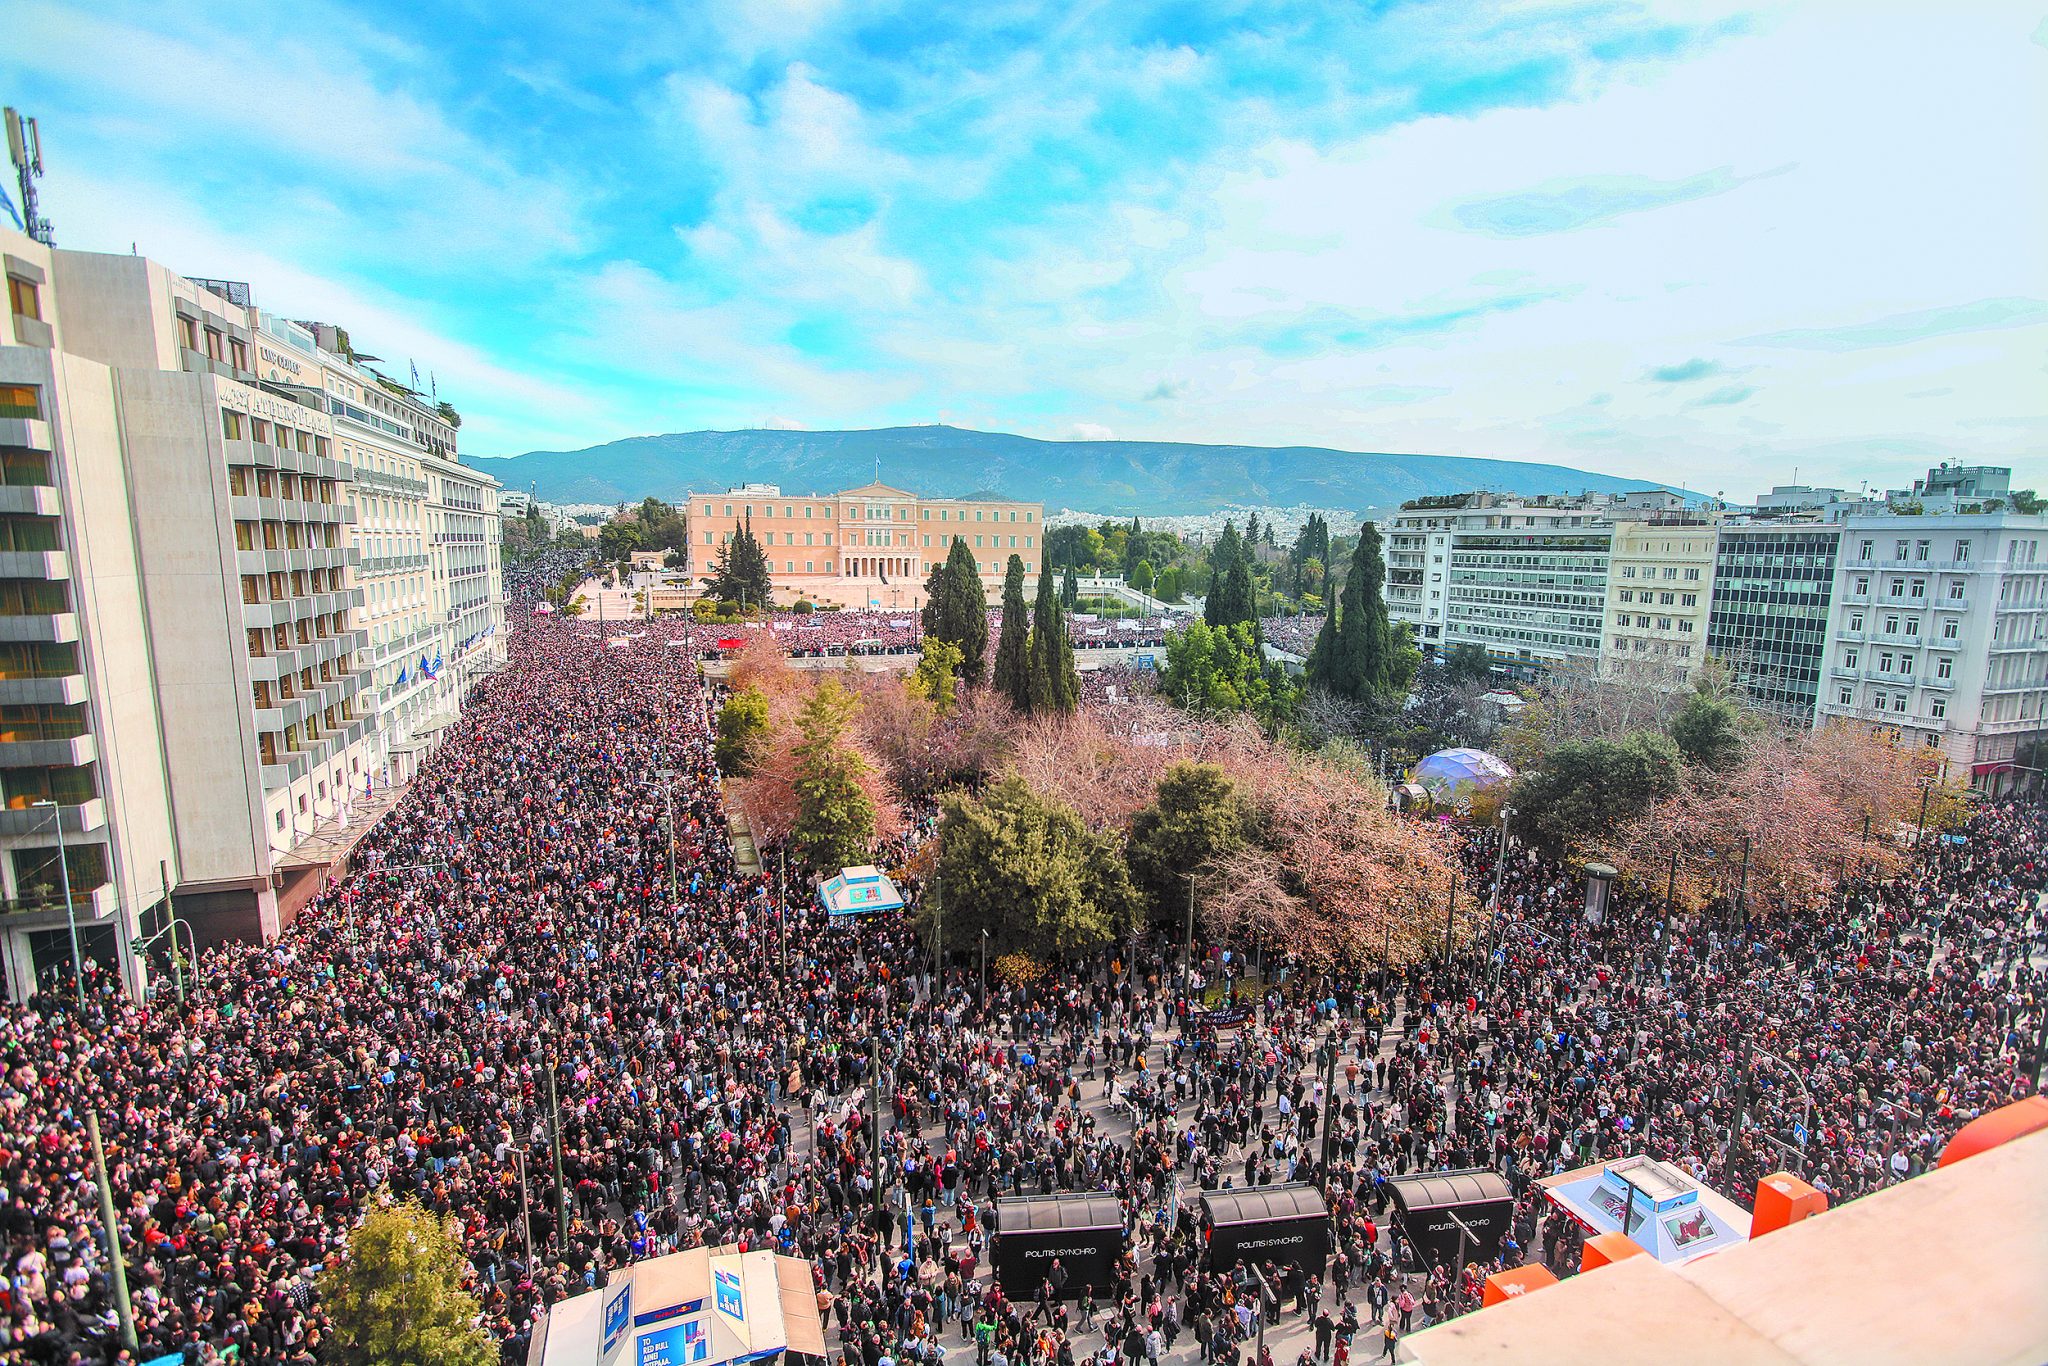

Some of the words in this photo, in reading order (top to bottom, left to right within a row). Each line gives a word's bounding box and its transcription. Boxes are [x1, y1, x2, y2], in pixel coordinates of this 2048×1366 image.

[1237, 1240, 1266, 1250] POLITIS
[1268, 1235, 1304, 1247] SYNCHRO
[1025, 1249, 1056, 1258] POLITIS
[1058, 1247, 1097, 1256] SYNCHRO
[643, 1345, 655, 1355] RED
[655, 1341, 669, 1352] BULL
